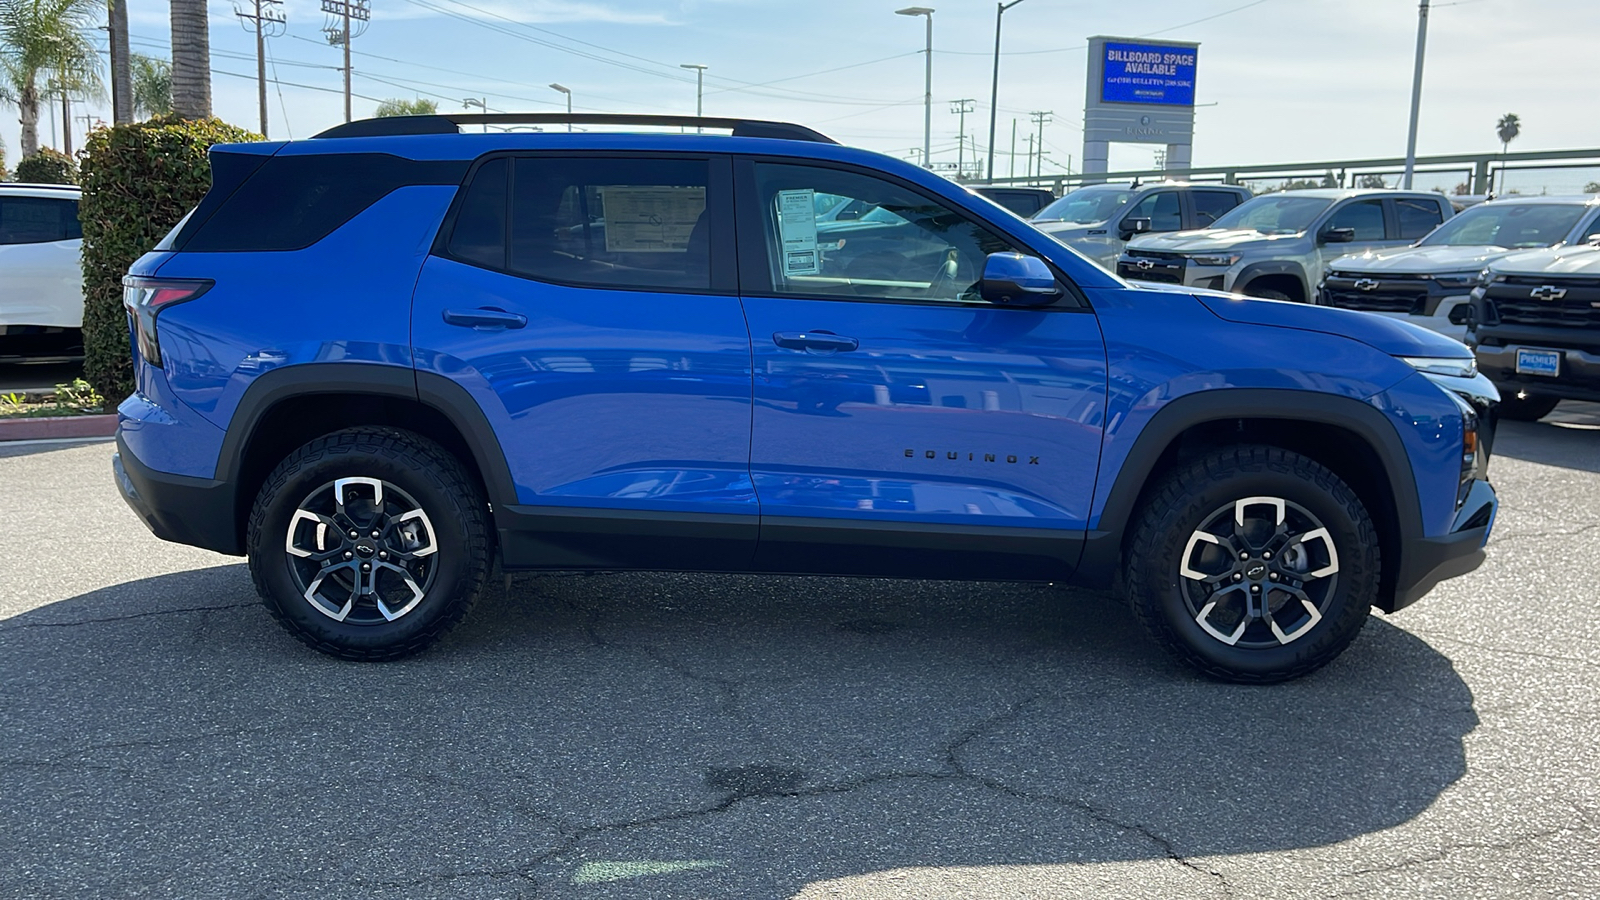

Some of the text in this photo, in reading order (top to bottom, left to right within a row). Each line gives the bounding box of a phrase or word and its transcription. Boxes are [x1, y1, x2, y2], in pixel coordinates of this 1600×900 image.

[1108, 50, 1194, 66] BILLBOARD SPACE
[1124, 62, 1176, 76] AVAILABLE
[904, 449, 1040, 465] EQUINOX
